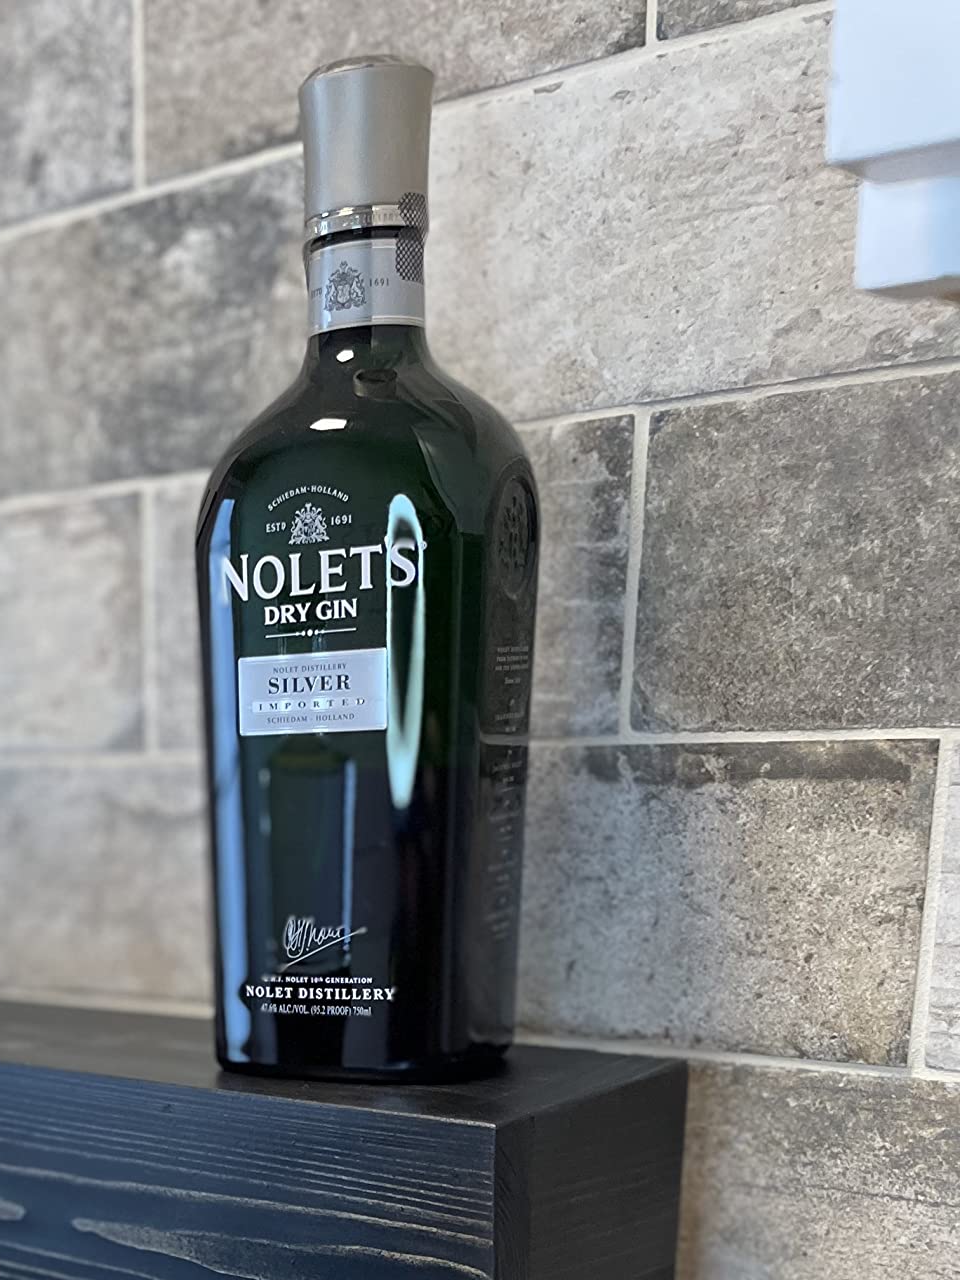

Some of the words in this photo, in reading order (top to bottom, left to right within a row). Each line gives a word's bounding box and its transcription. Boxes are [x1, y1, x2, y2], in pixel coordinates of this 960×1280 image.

[369, 278, 390, 288] 1691
[330, 513, 353, 526] 1691
[263, 602, 313, 626] DRY
[315, 598, 358, 621] GIN
[273, 665, 299, 675] NOLET
[301, 663, 347, 673] DISTILLERY
[268, 674, 352, 695] SILVER
[258, 698, 366, 712] IMPORTED
[266, 715, 308, 725] SCHIEDAM
[315, 713, 356, 722] HOLLAND
[285, 976, 308, 984] NOLET
[245, 984, 293, 999] NOLET
[298, 986, 396, 1001] DISTILLERY
